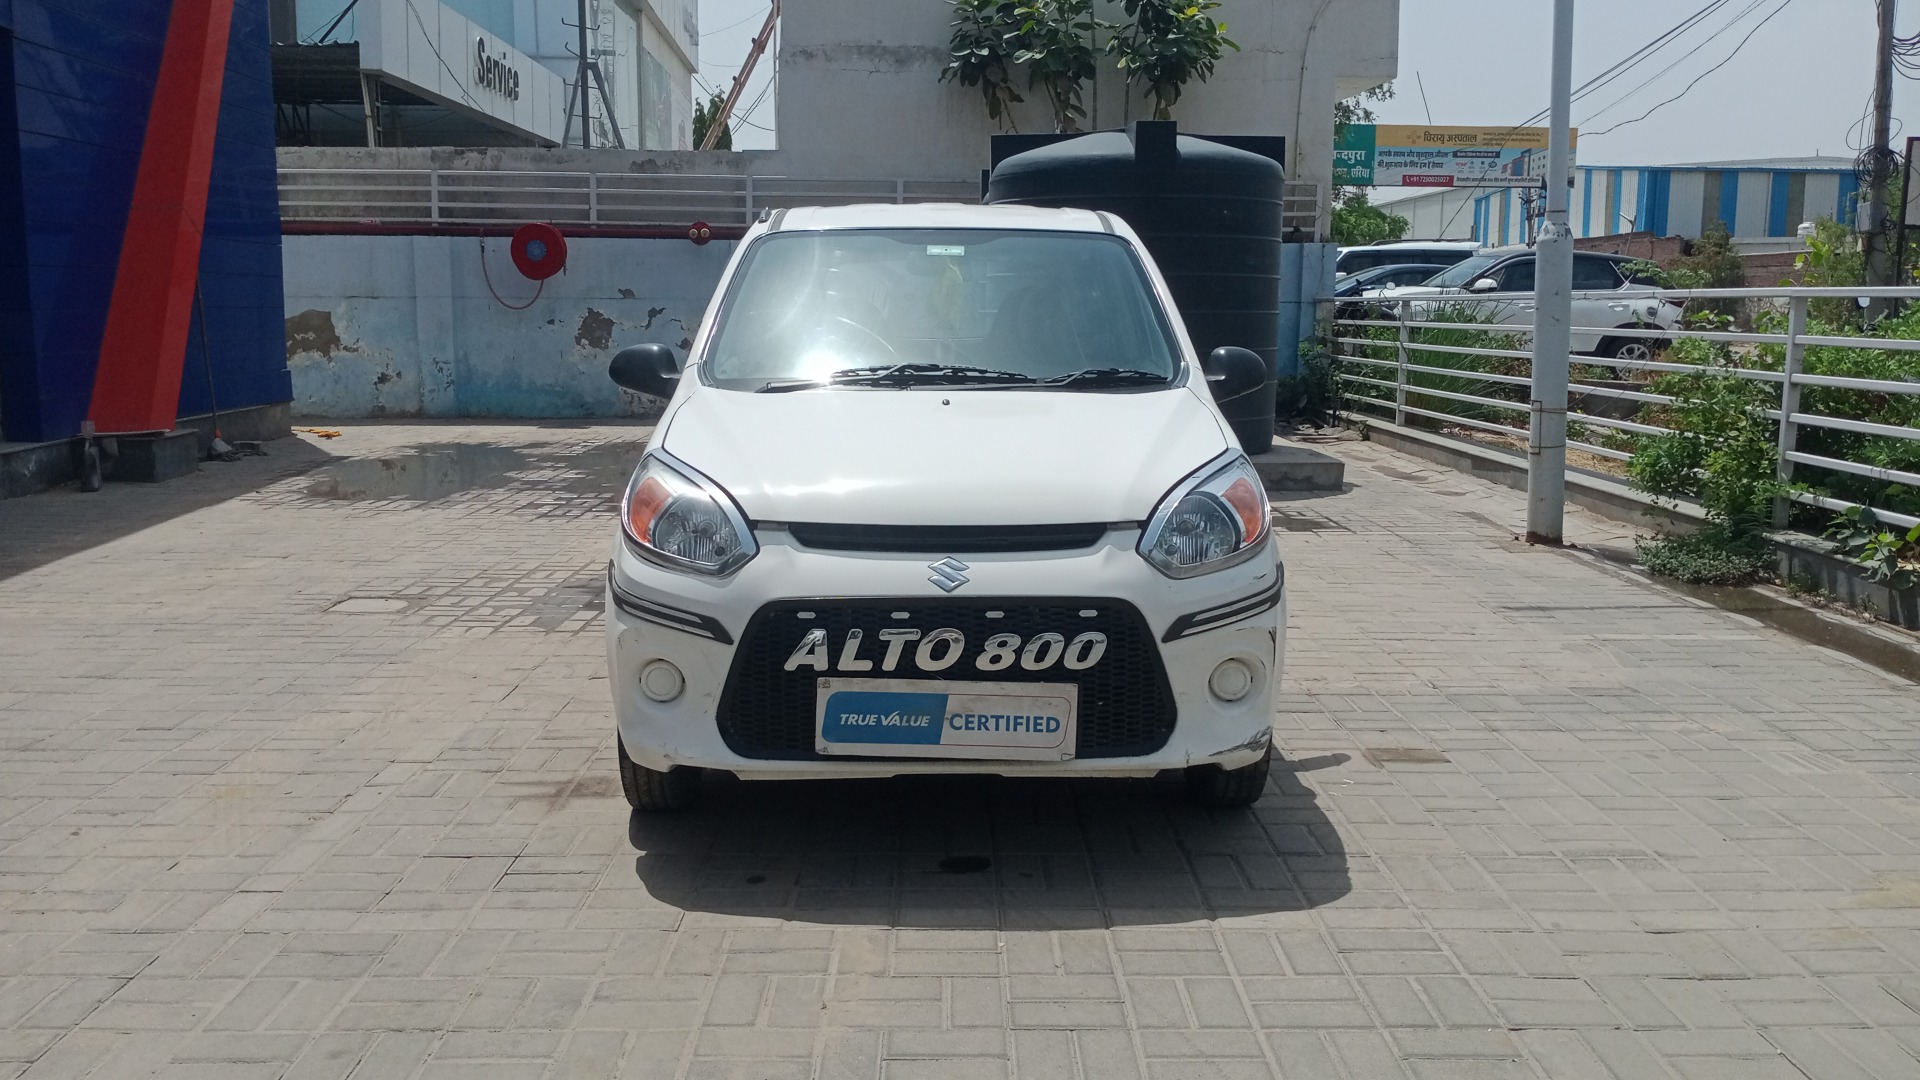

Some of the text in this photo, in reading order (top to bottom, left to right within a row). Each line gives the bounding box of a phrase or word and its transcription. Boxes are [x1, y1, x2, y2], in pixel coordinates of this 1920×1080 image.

[476, 36, 519, 101] Service
[1446, 134, 1477, 142] अस्पताल
[784, 628, 1108, 672] ALTO 800
[839, 710, 1061, 734] TRUE VALUE CERTIFIED
